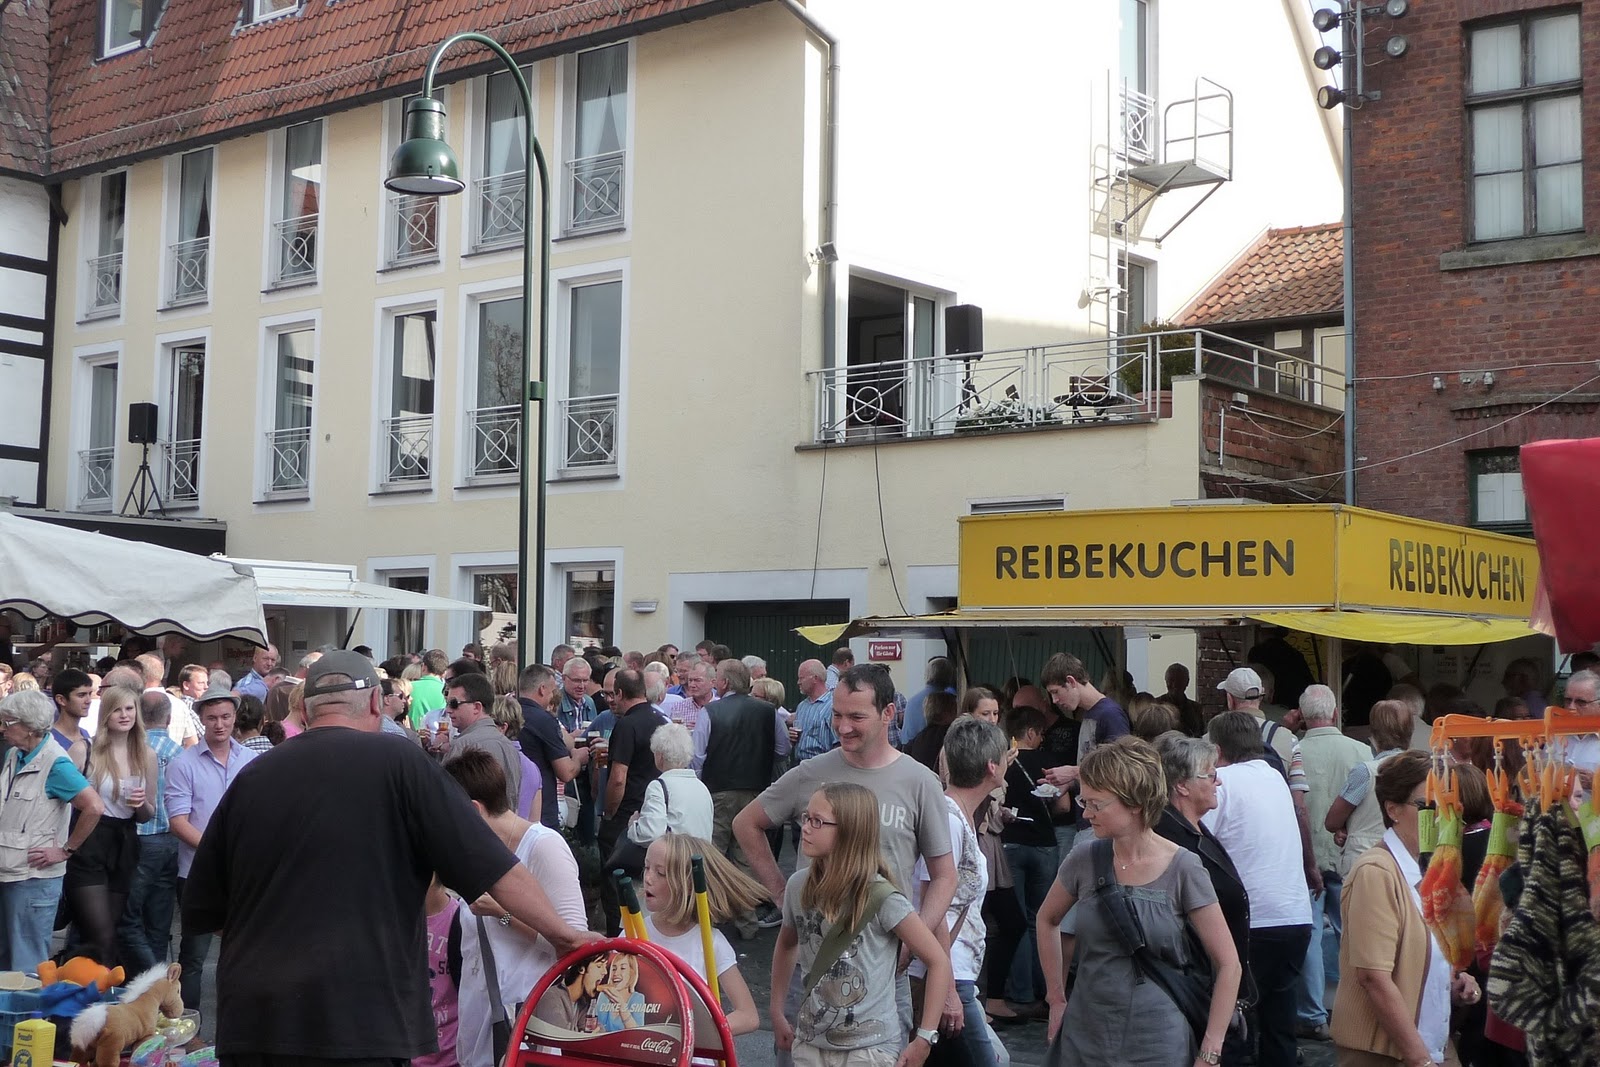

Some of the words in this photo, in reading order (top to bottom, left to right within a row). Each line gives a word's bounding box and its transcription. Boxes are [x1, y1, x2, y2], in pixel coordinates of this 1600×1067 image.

[996, 539, 1295, 580] REIBEKUCHEN
[1389, 538, 1525, 602] REIBEKUCHEN
[600, 1002, 621, 1012] COKE
[630, 1003, 661, 1013] SNACK!
